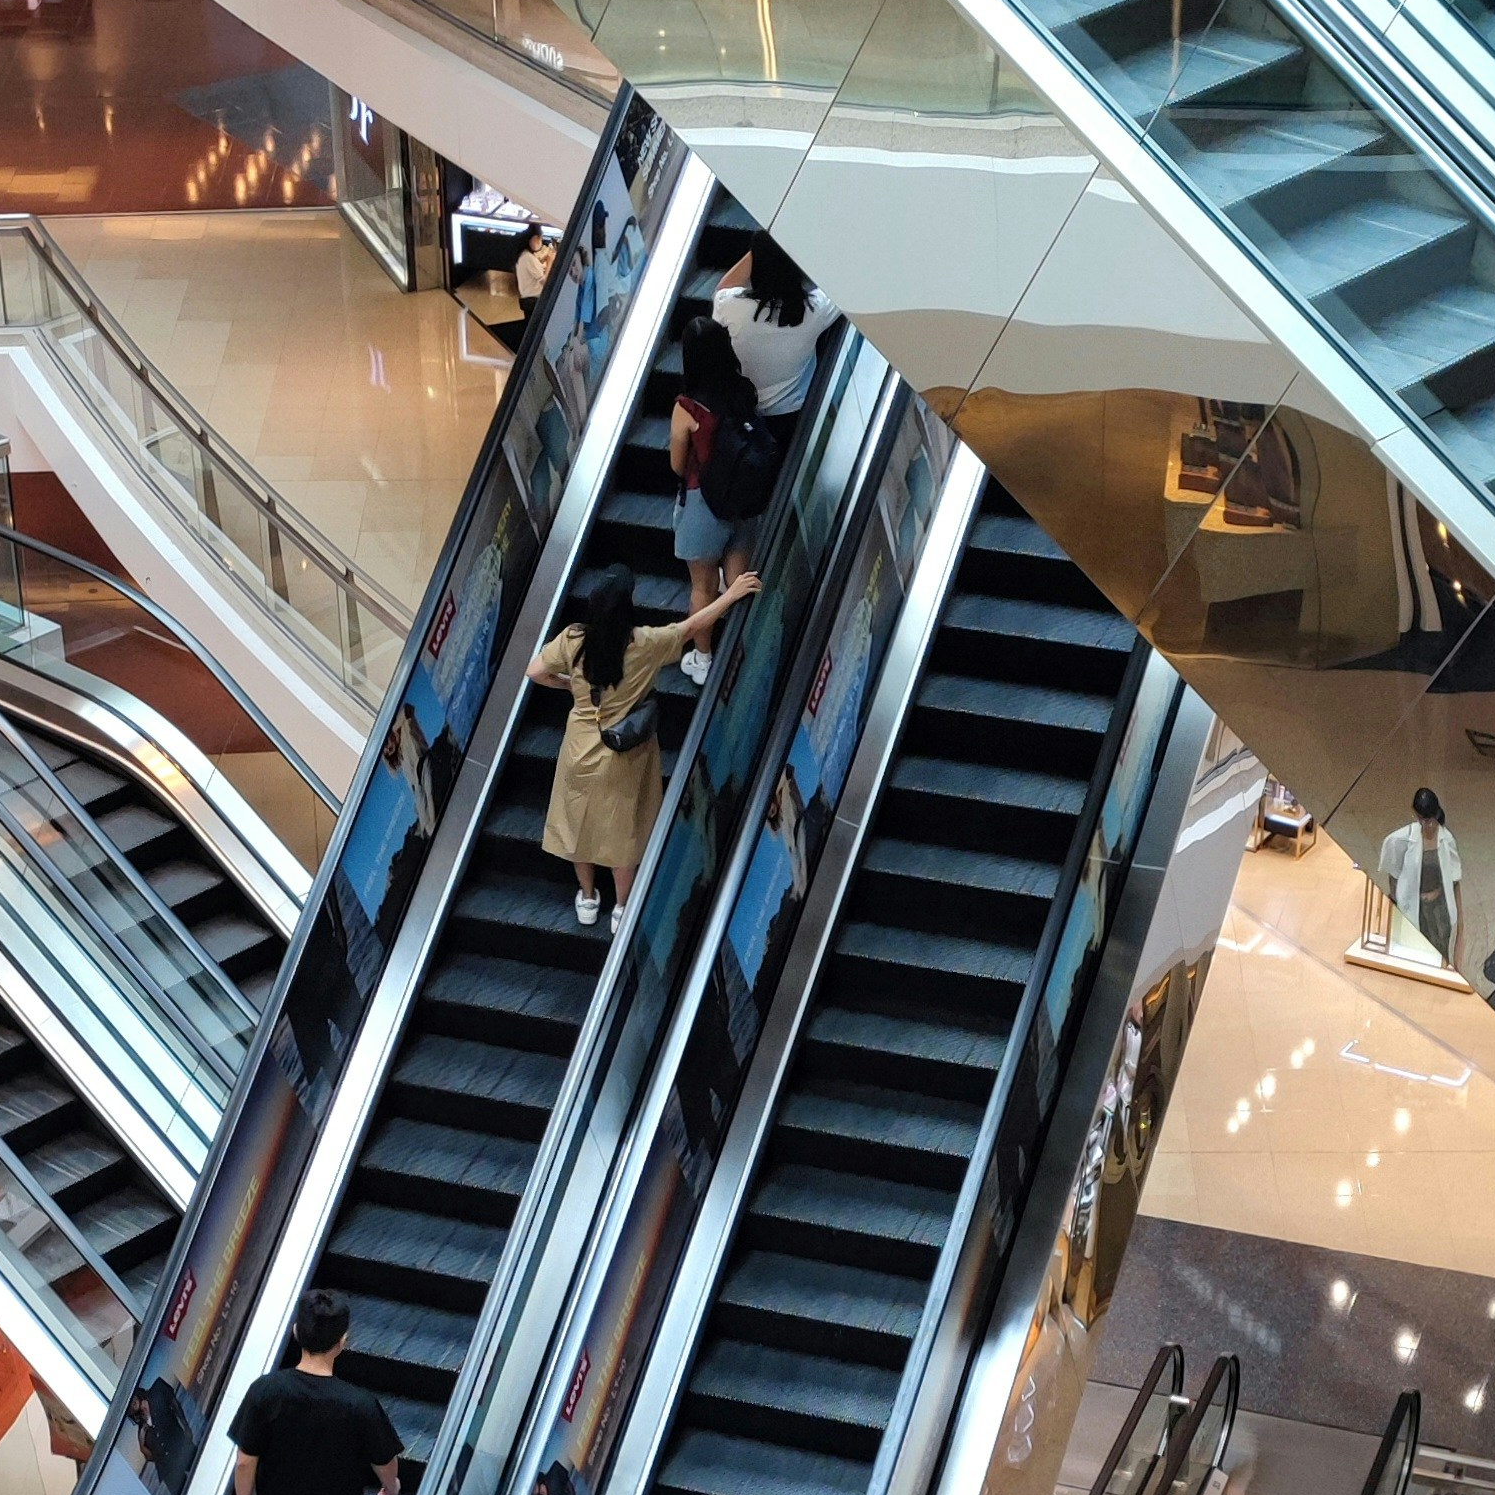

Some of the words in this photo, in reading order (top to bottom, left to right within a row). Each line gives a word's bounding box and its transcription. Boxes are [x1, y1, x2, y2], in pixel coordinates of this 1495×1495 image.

[182, 1316, 209, 1369] FEEL
[203, 1262, 227, 1312] THE
[222, 1173, 261, 1266] BREEZE
[196, 1347, 214, 1386] Shop
[221, 1279, 240, 1321] L1-10
